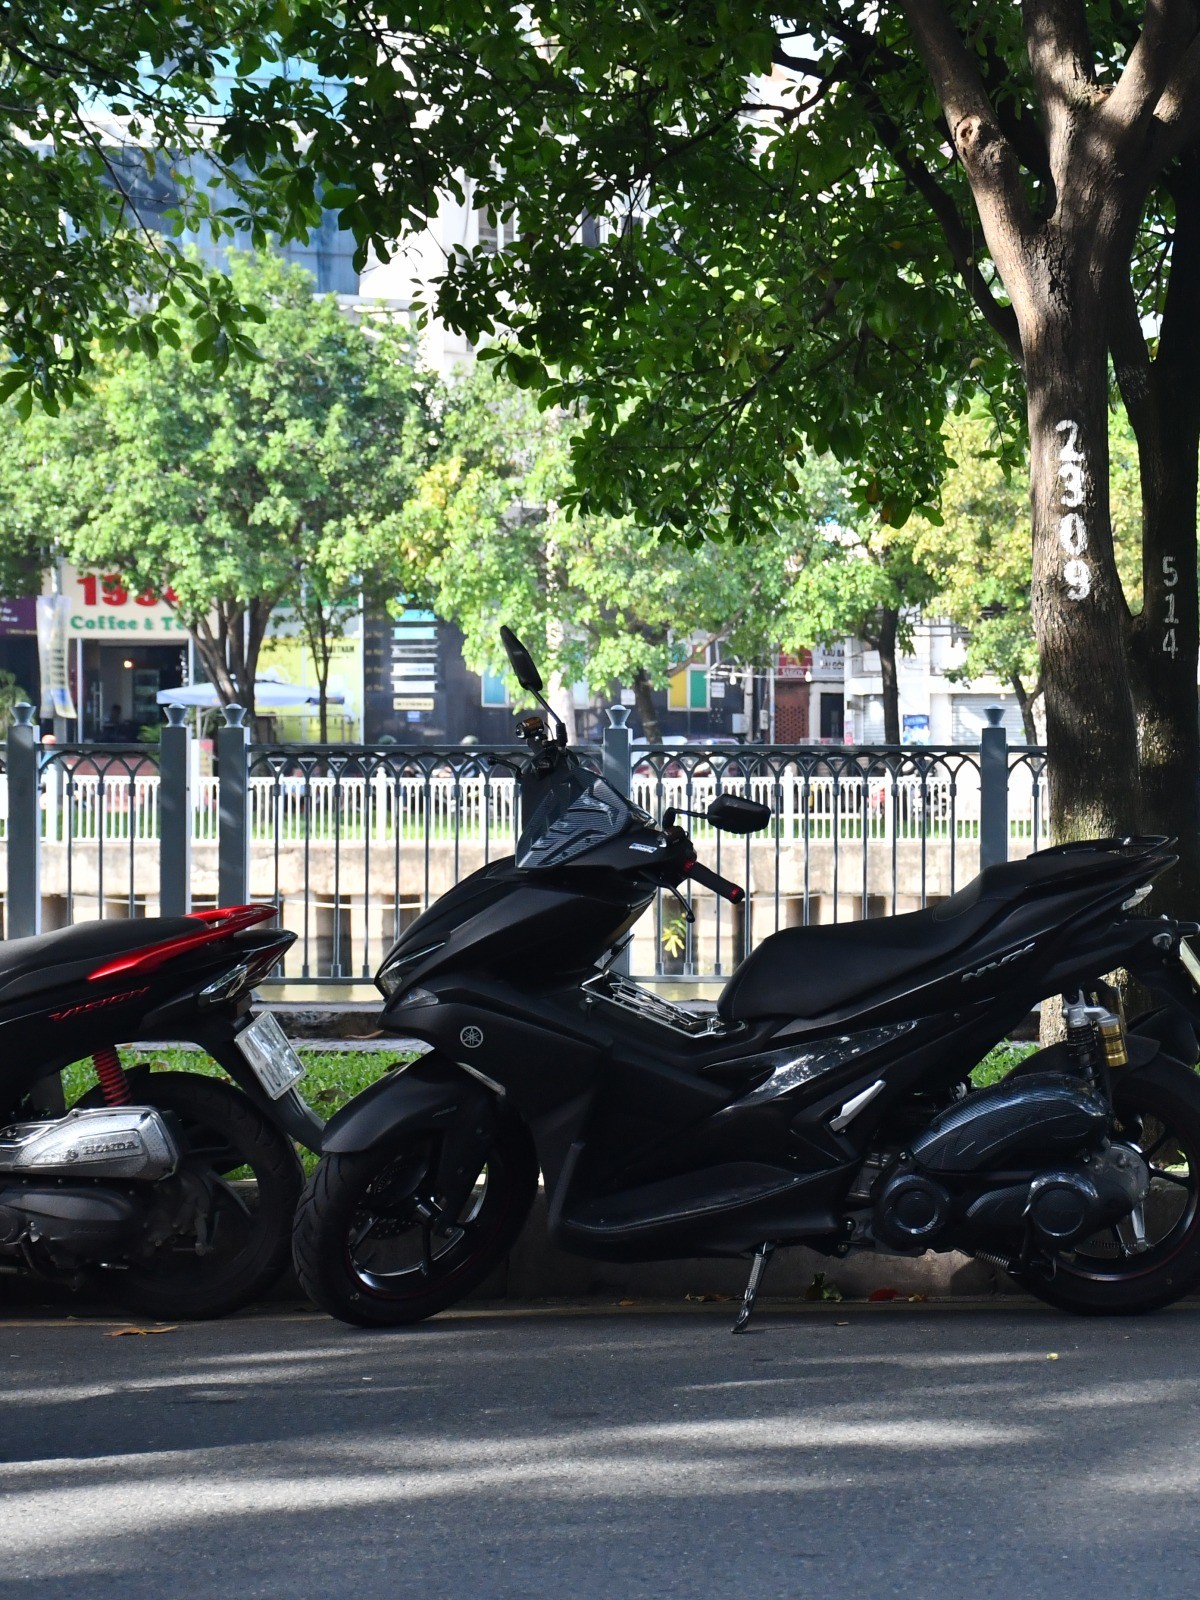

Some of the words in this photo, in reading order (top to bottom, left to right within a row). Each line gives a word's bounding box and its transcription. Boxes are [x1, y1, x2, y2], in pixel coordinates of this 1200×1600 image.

[77, 574, 183, 606] 19
[1162, 556, 1179, 659] 514
[70, 615, 137, 630] Coffee
[143, 616, 155, 631] &
[161, 616, 186, 631] Te
[82, 1141, 139, 1156] HONDA
